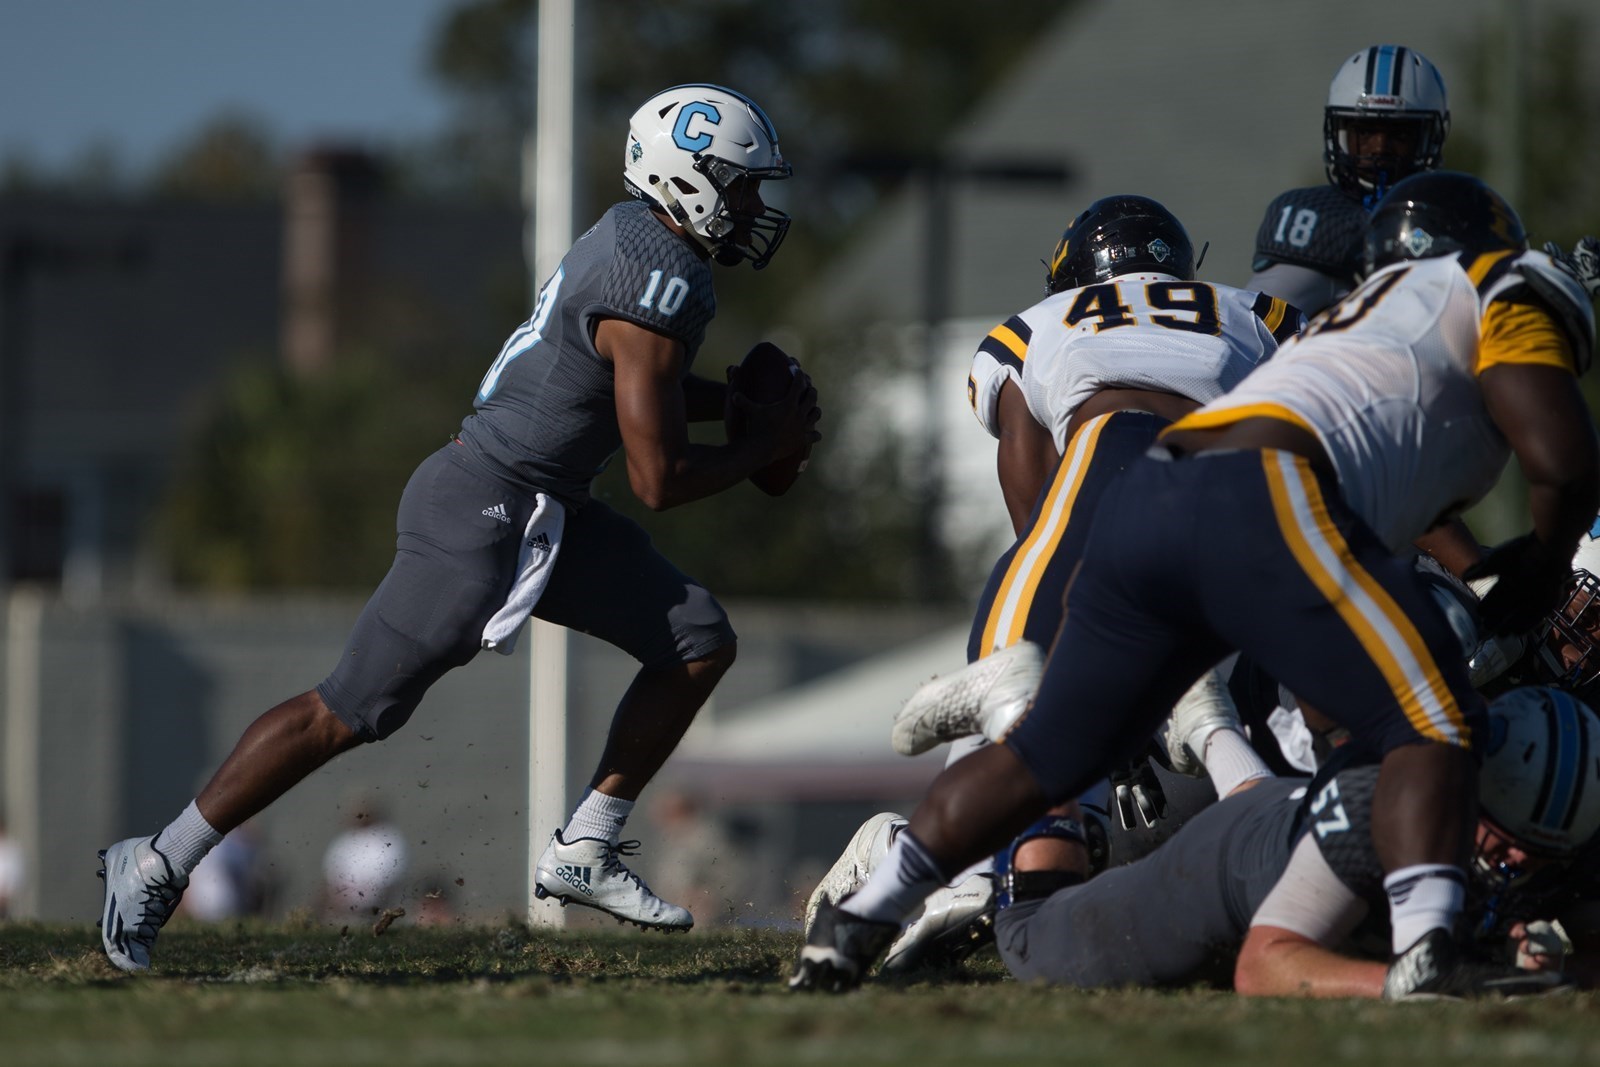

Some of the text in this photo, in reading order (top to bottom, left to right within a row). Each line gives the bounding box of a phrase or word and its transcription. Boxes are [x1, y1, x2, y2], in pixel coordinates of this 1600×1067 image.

[671, 101, 722, 153] C
[1274, 205, 1318, 247] 18
[638, 269, 690, 317] 10
[1062, 281, 1222, 337] 49
[481, 509, 512, 524] adidas
[1310, 777, 1351, 839] 57
[555, 866, 594, 897] adidas
